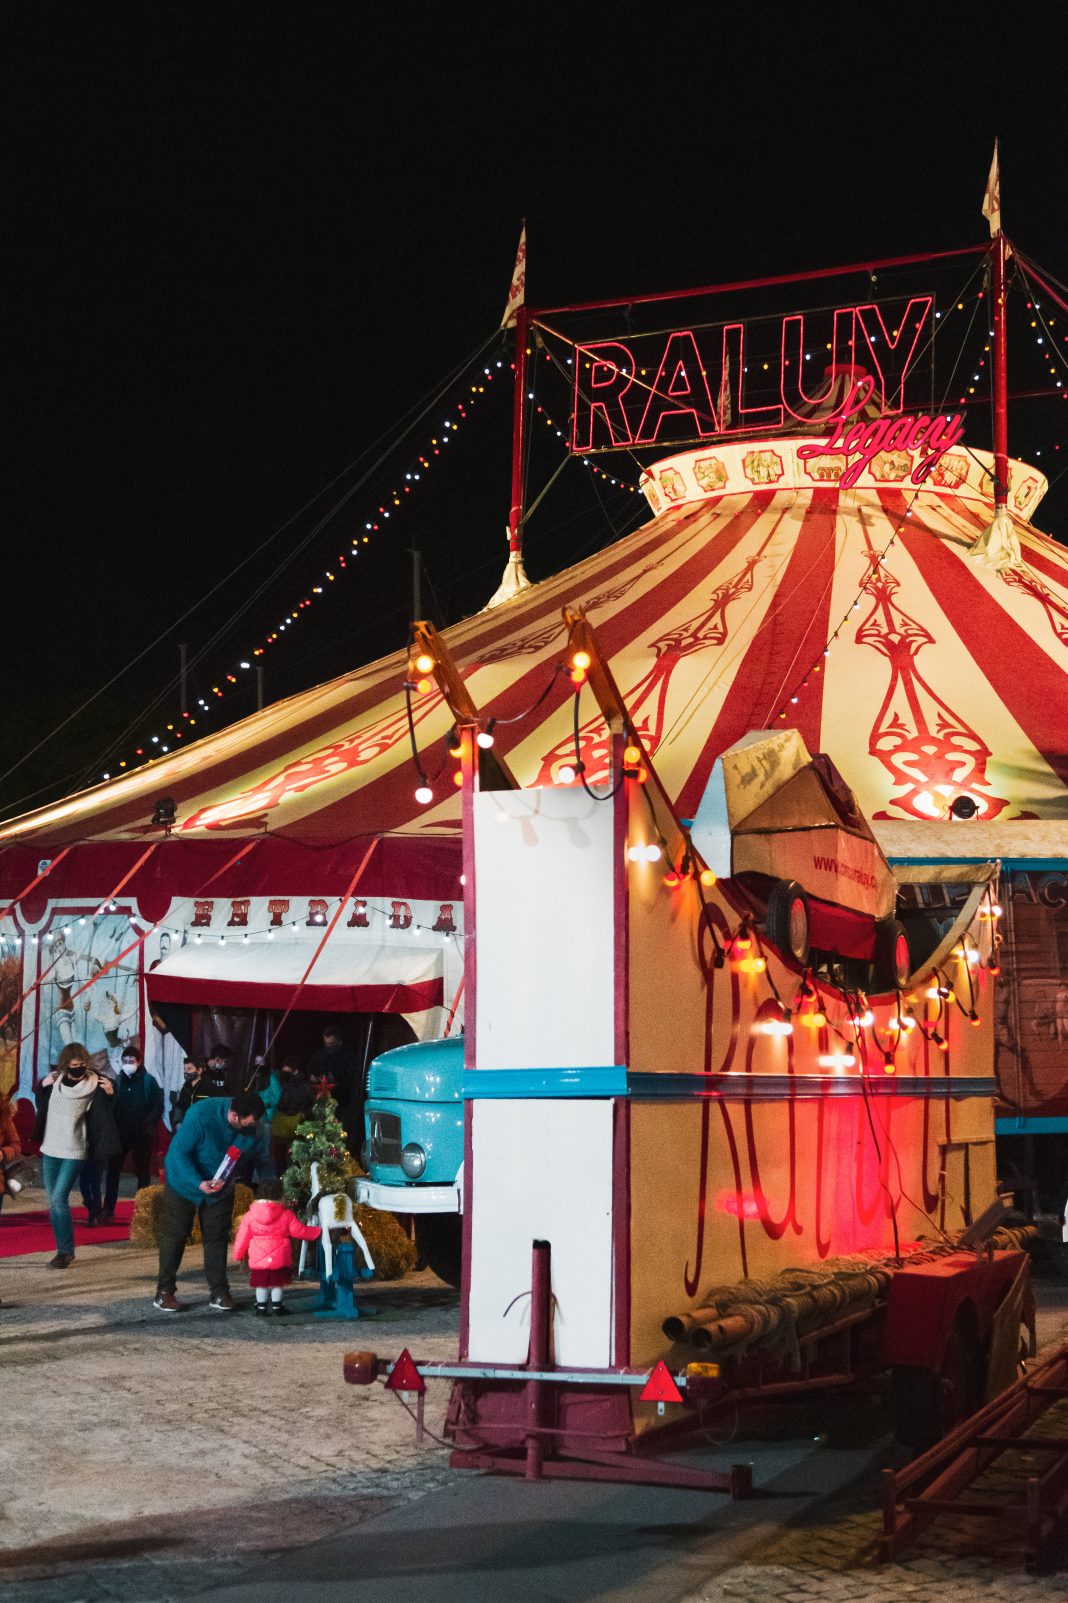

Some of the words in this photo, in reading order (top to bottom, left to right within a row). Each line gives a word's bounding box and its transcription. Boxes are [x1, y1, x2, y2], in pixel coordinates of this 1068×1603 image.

[572, 297, 933, 452] RALUY
[797, 375, 965, 490] Legacy
[190, 899, 457, 932] ENTRADA
